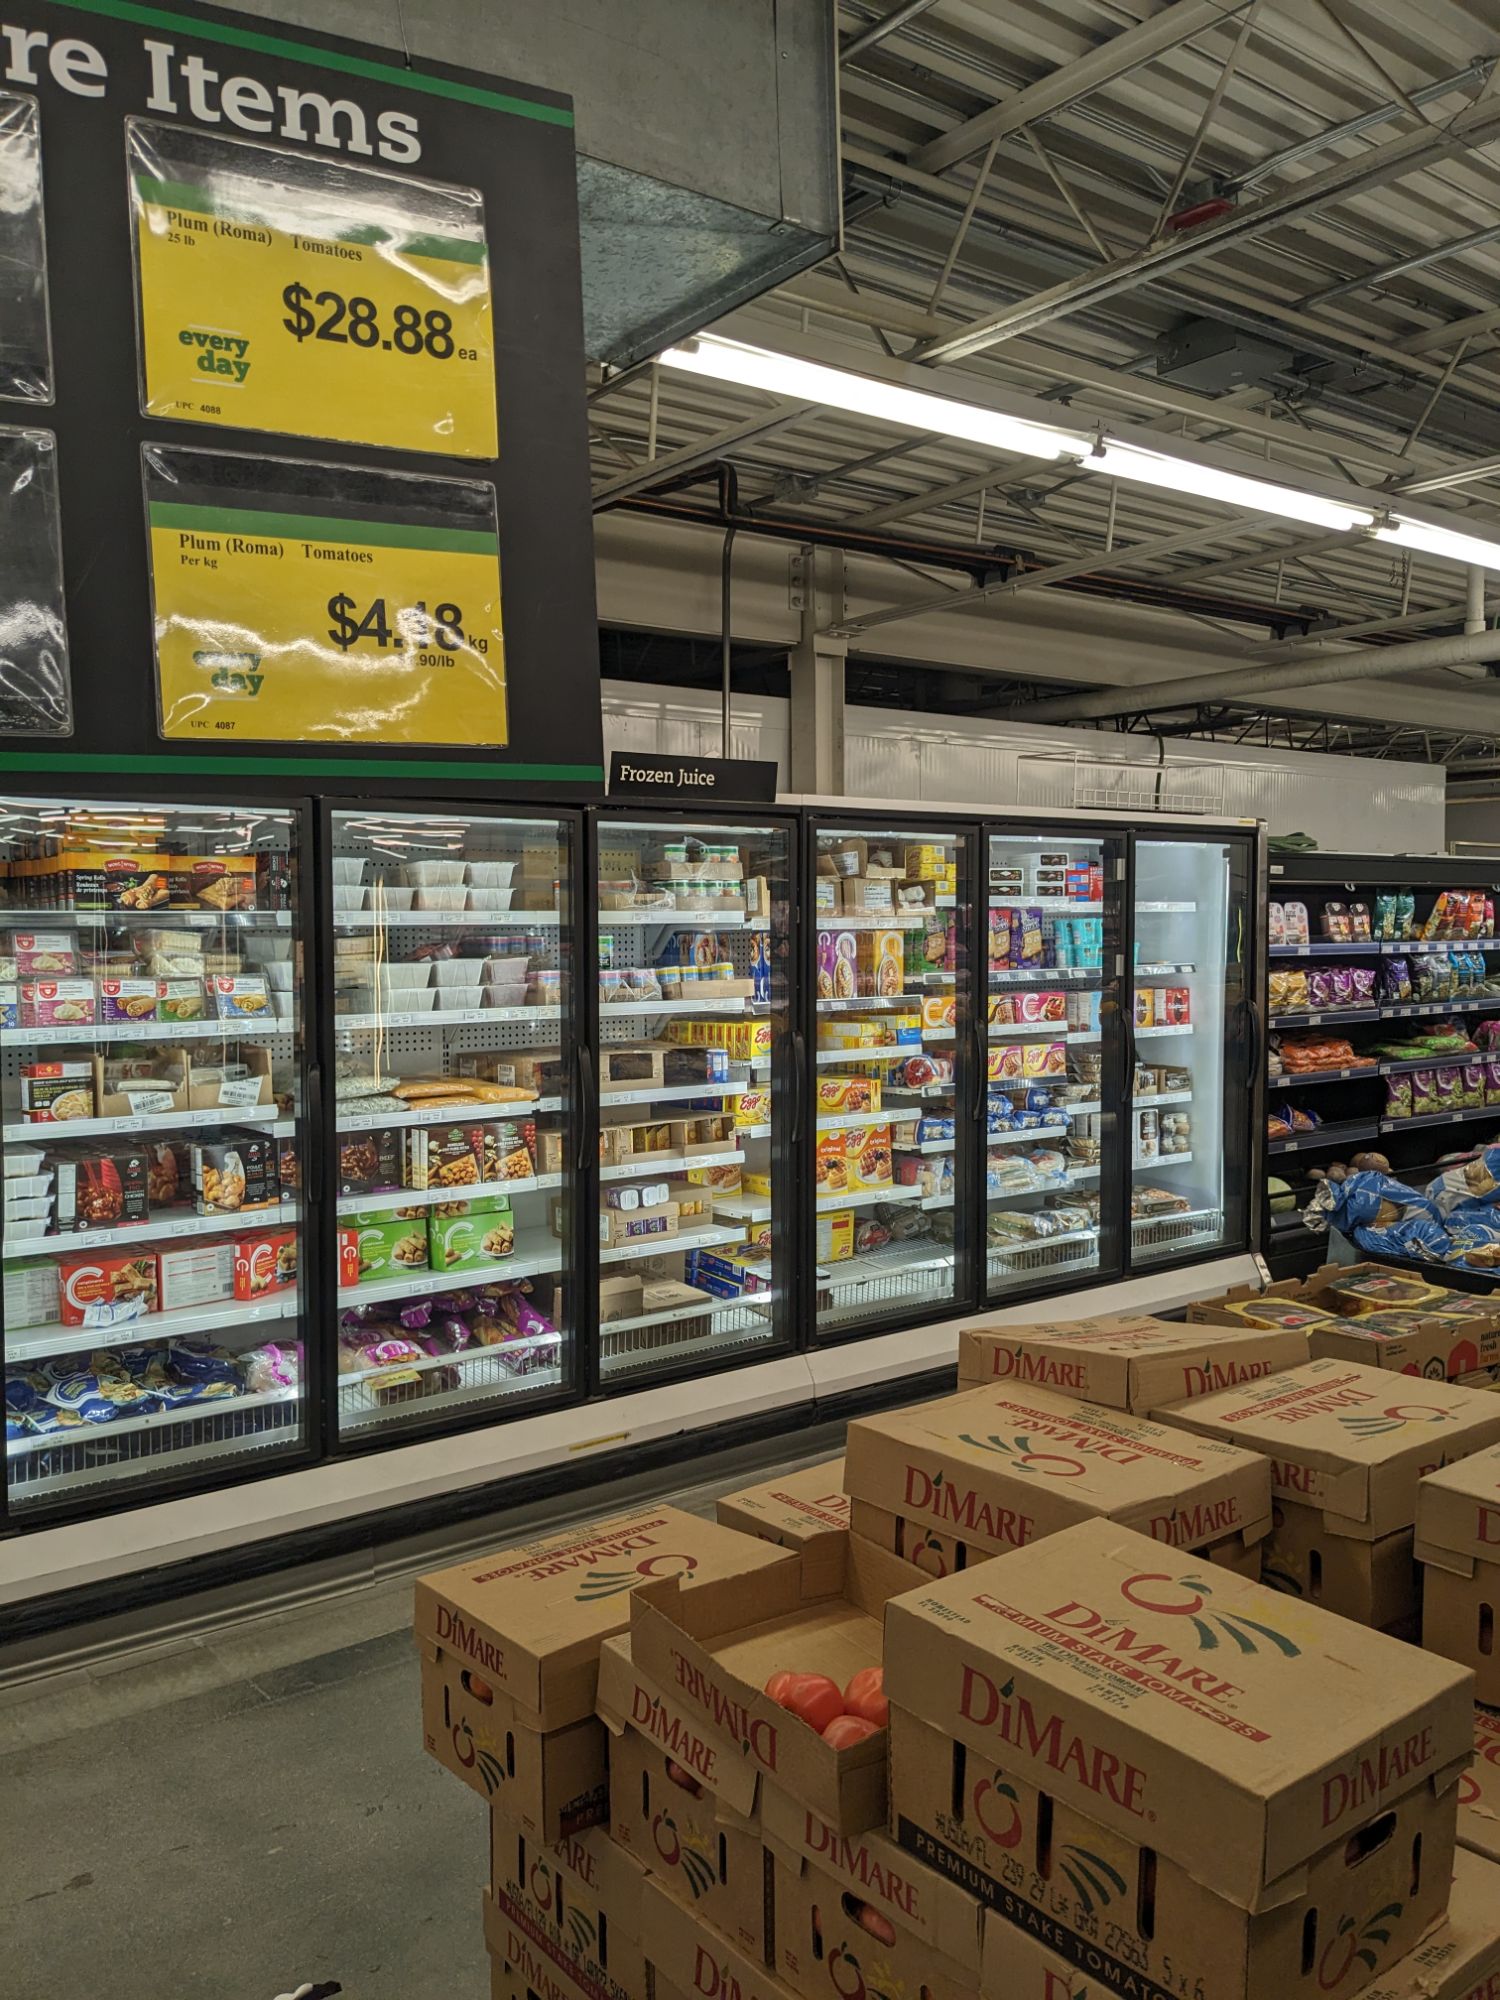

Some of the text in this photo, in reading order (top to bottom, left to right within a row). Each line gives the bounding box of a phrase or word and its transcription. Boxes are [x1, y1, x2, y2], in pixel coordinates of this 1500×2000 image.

[143, 39, 422, 164] Items
[167, 210, 363, 262] Plum (Roma) Tomatoes
[167, 232, 196, 247] 25 lb
[281, 280, 478, 361] $28.88 ea
[178, 328, 250, 360] every
[196, 352, 252, 383] day
[175, 400, 222, 416] UPC 4088
[179, 533, 374, 564] Plum (Roma) Tomatoes
[180, 554, 219, 570] Per kg
[468, 634, 489, 652] kg
[210, 667, 265, 696] day
[190, 721, 236, 731] UPC 4087
[619, 765, 716, 788] Frozen Juice
[740, 1094, 761, 1111] Eggo
[820, 1082, 841, 1098] Eggo
[845, 1130, 867, 1149] Eggo
[992, 1346, 1090, 1390] DiMARE
[1182, 1357, 1273, 1398] DiMARE
[1007, 1417, 1146, 1465] DiMARE
[904, 1464, 1035, 1546] DiMARE
[1149, 1495, 1240, 1549] DiMARE
[526, 1535, 660, 1584] DiMARE
[436, 1604, 507, 1681] DiMARE
[1043, 1600, 1245, 1706] DiMARE
[1070, 1643, 1130, 1676] STAKE
[1135, 1674, 1256, 1739] TOMATOES
[1102, 1671, 1149, 1697] COMPANY
[671, 1648, 778, 1773] DiMARE
[631, 1684, 718, 1786] DiMARE
[959, 1662, 1147, 1818] DiMARE
[1321, 1726, 1435, 1829] DiMARE
[804, 1809, 920, 1921] DiMARE
[915, 1833, 995, 1899] PREMIUM
[1004, 1895, 1065, 1947] STAKE
